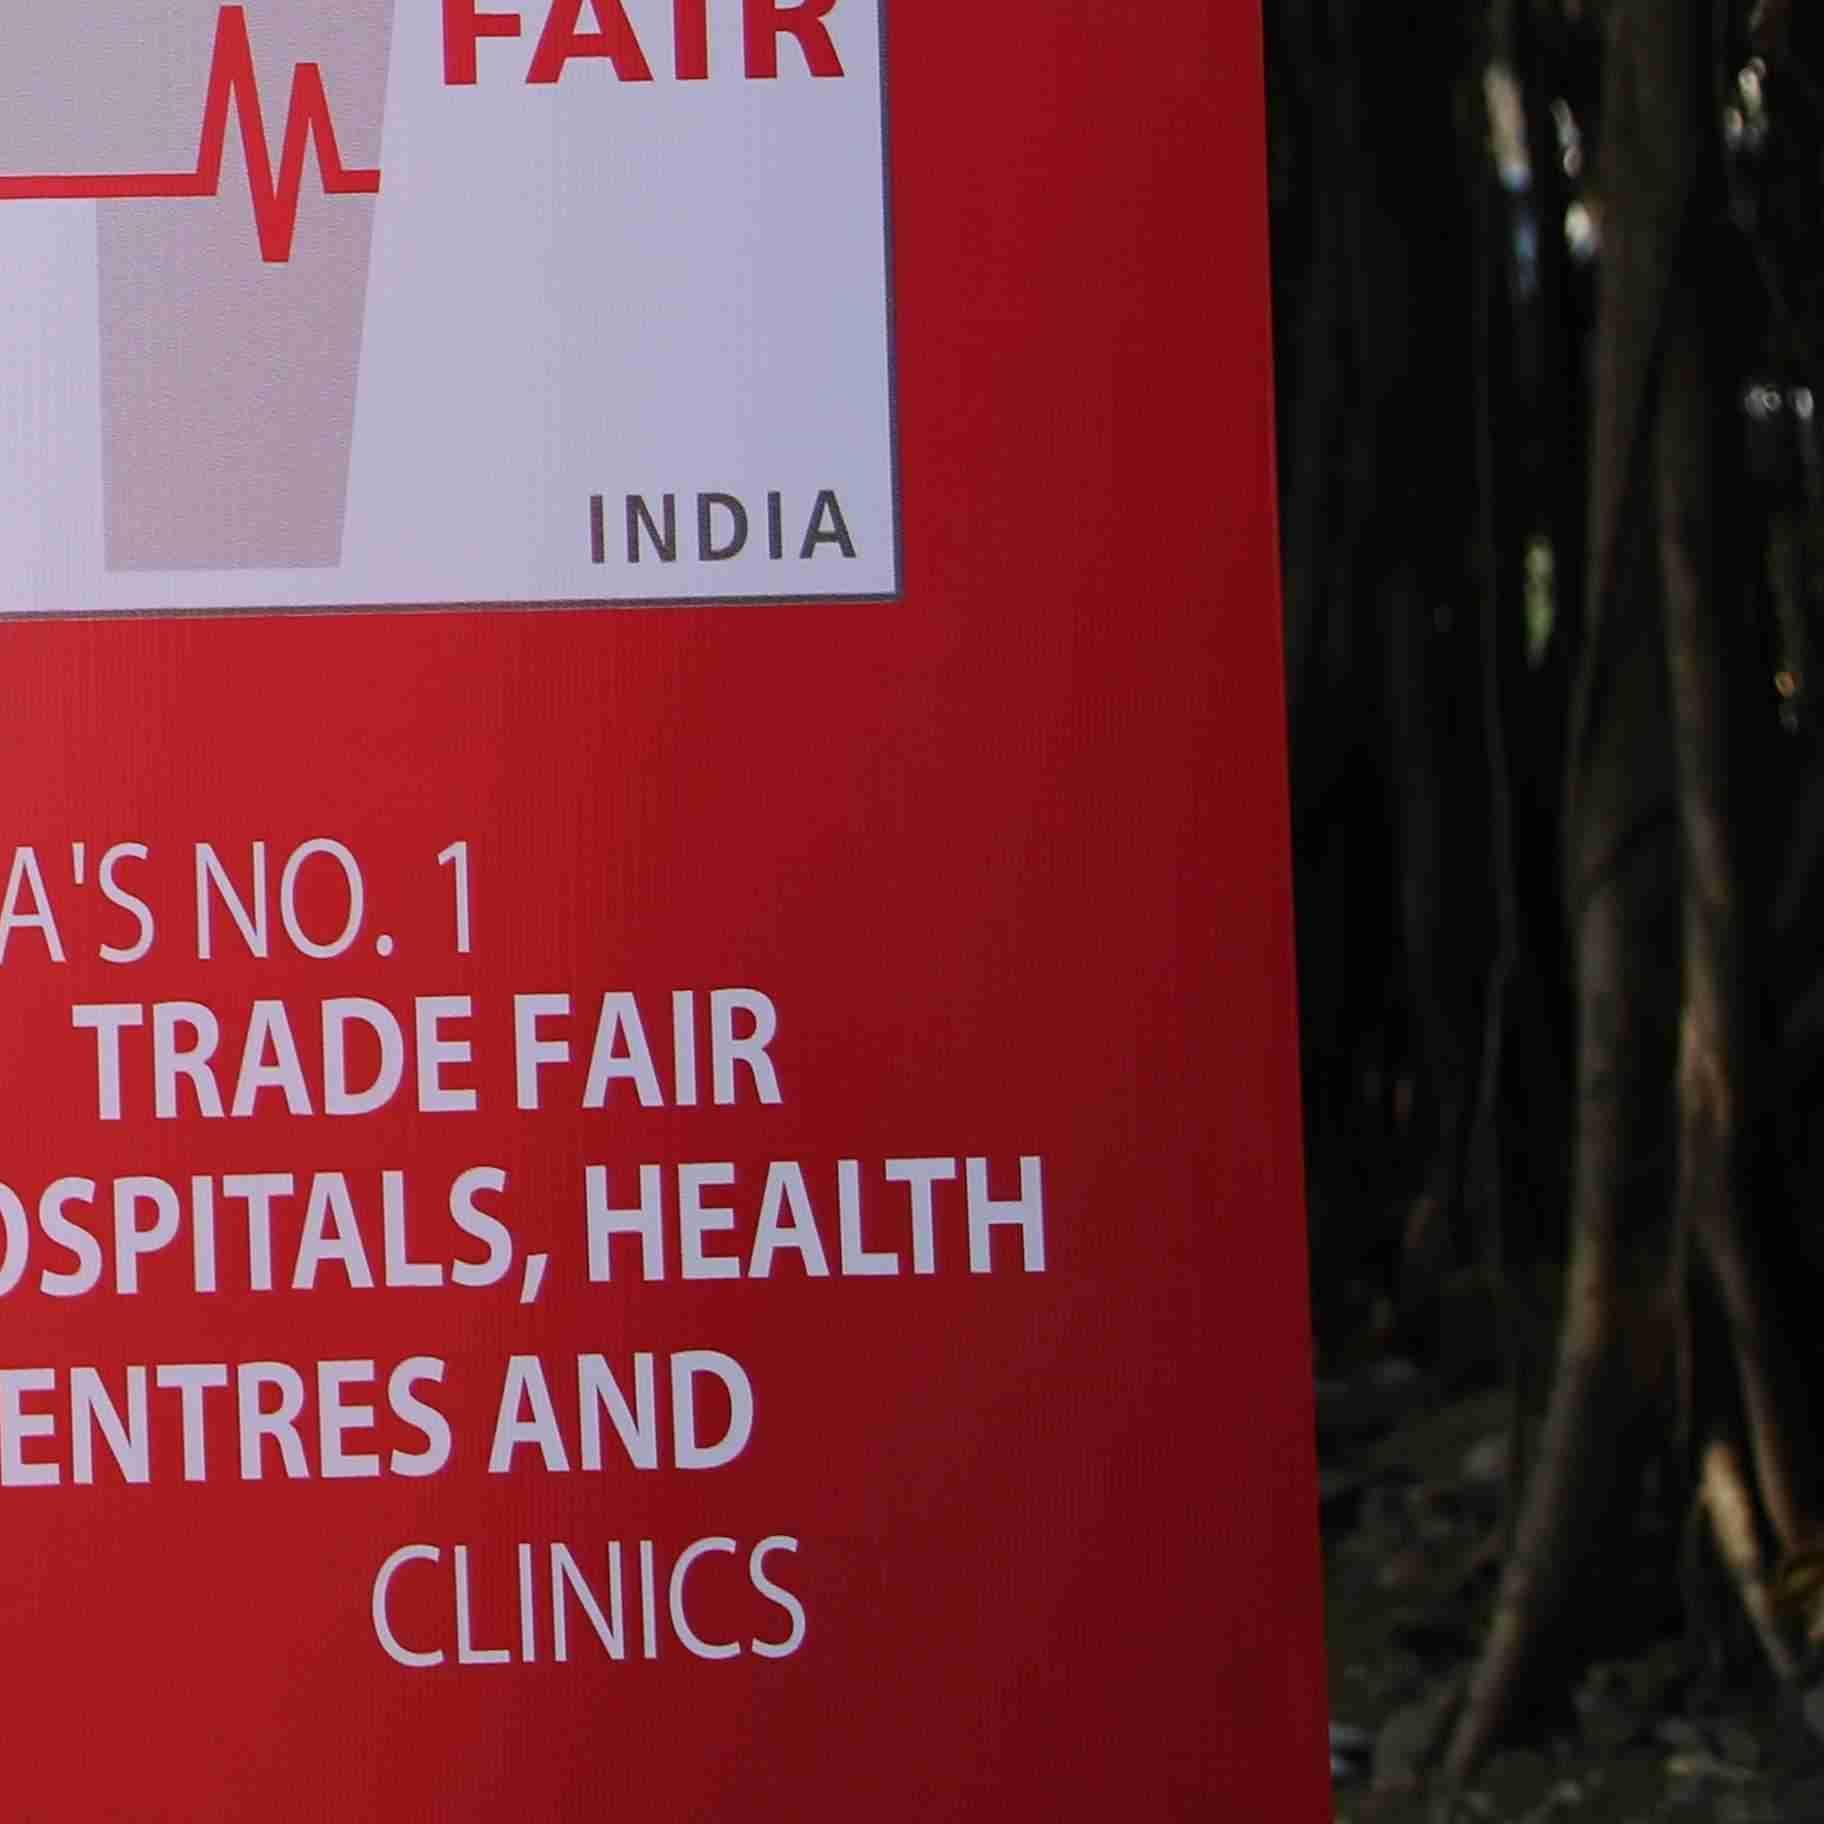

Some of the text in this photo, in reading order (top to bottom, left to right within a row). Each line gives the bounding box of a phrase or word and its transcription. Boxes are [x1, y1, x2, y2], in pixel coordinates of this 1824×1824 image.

[589, 489, 857, 565] INDIA
[196, 837, 395, 962] NO.
[437, 841, 475, 954] 1
[72, 987, 784, 1121] TRADE FAIR
[583, 1155, 1048, 1284] HEALTH
[487, 1350, 756, 1475] AND
[371, 1535, 807, 1668] CLINICS
